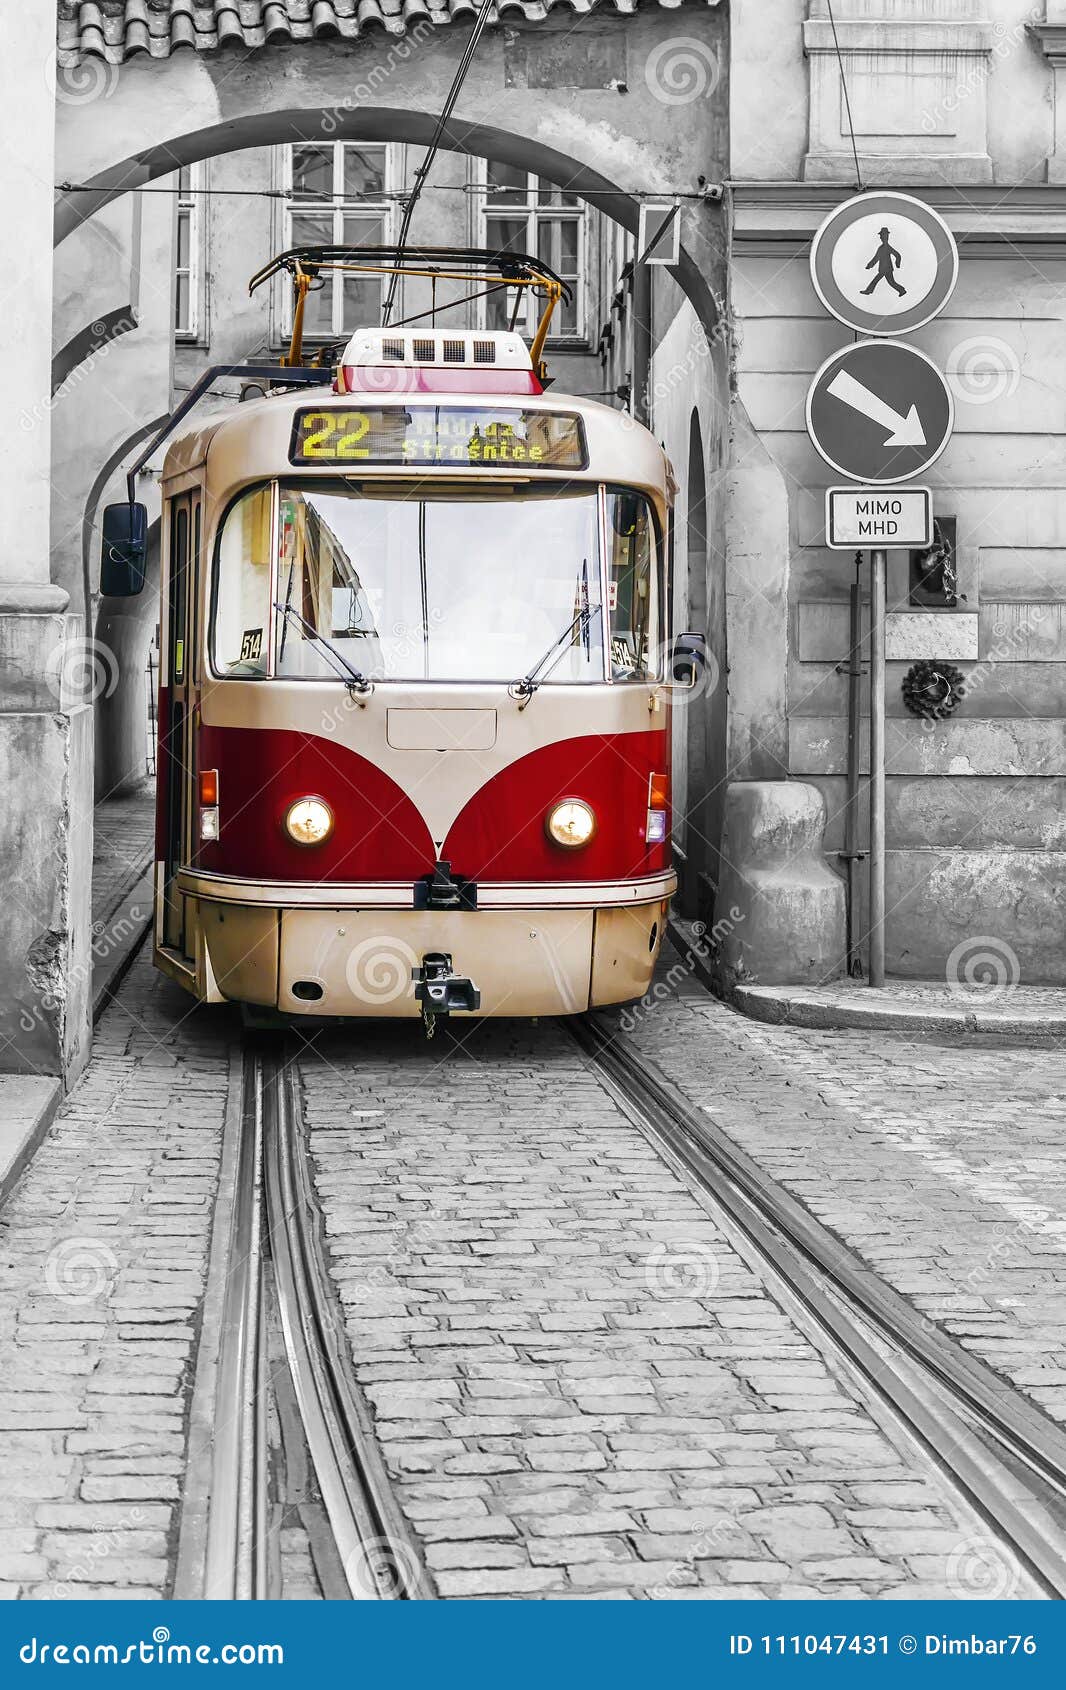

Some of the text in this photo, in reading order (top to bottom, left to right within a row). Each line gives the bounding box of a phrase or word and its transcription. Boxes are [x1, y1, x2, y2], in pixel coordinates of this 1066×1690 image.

[303, 412, 369, 457] 22
[856, 500, 902, 515] MIMO
[859, 520, 898, 535] MHD
[241, 633, 261, 660] 514
